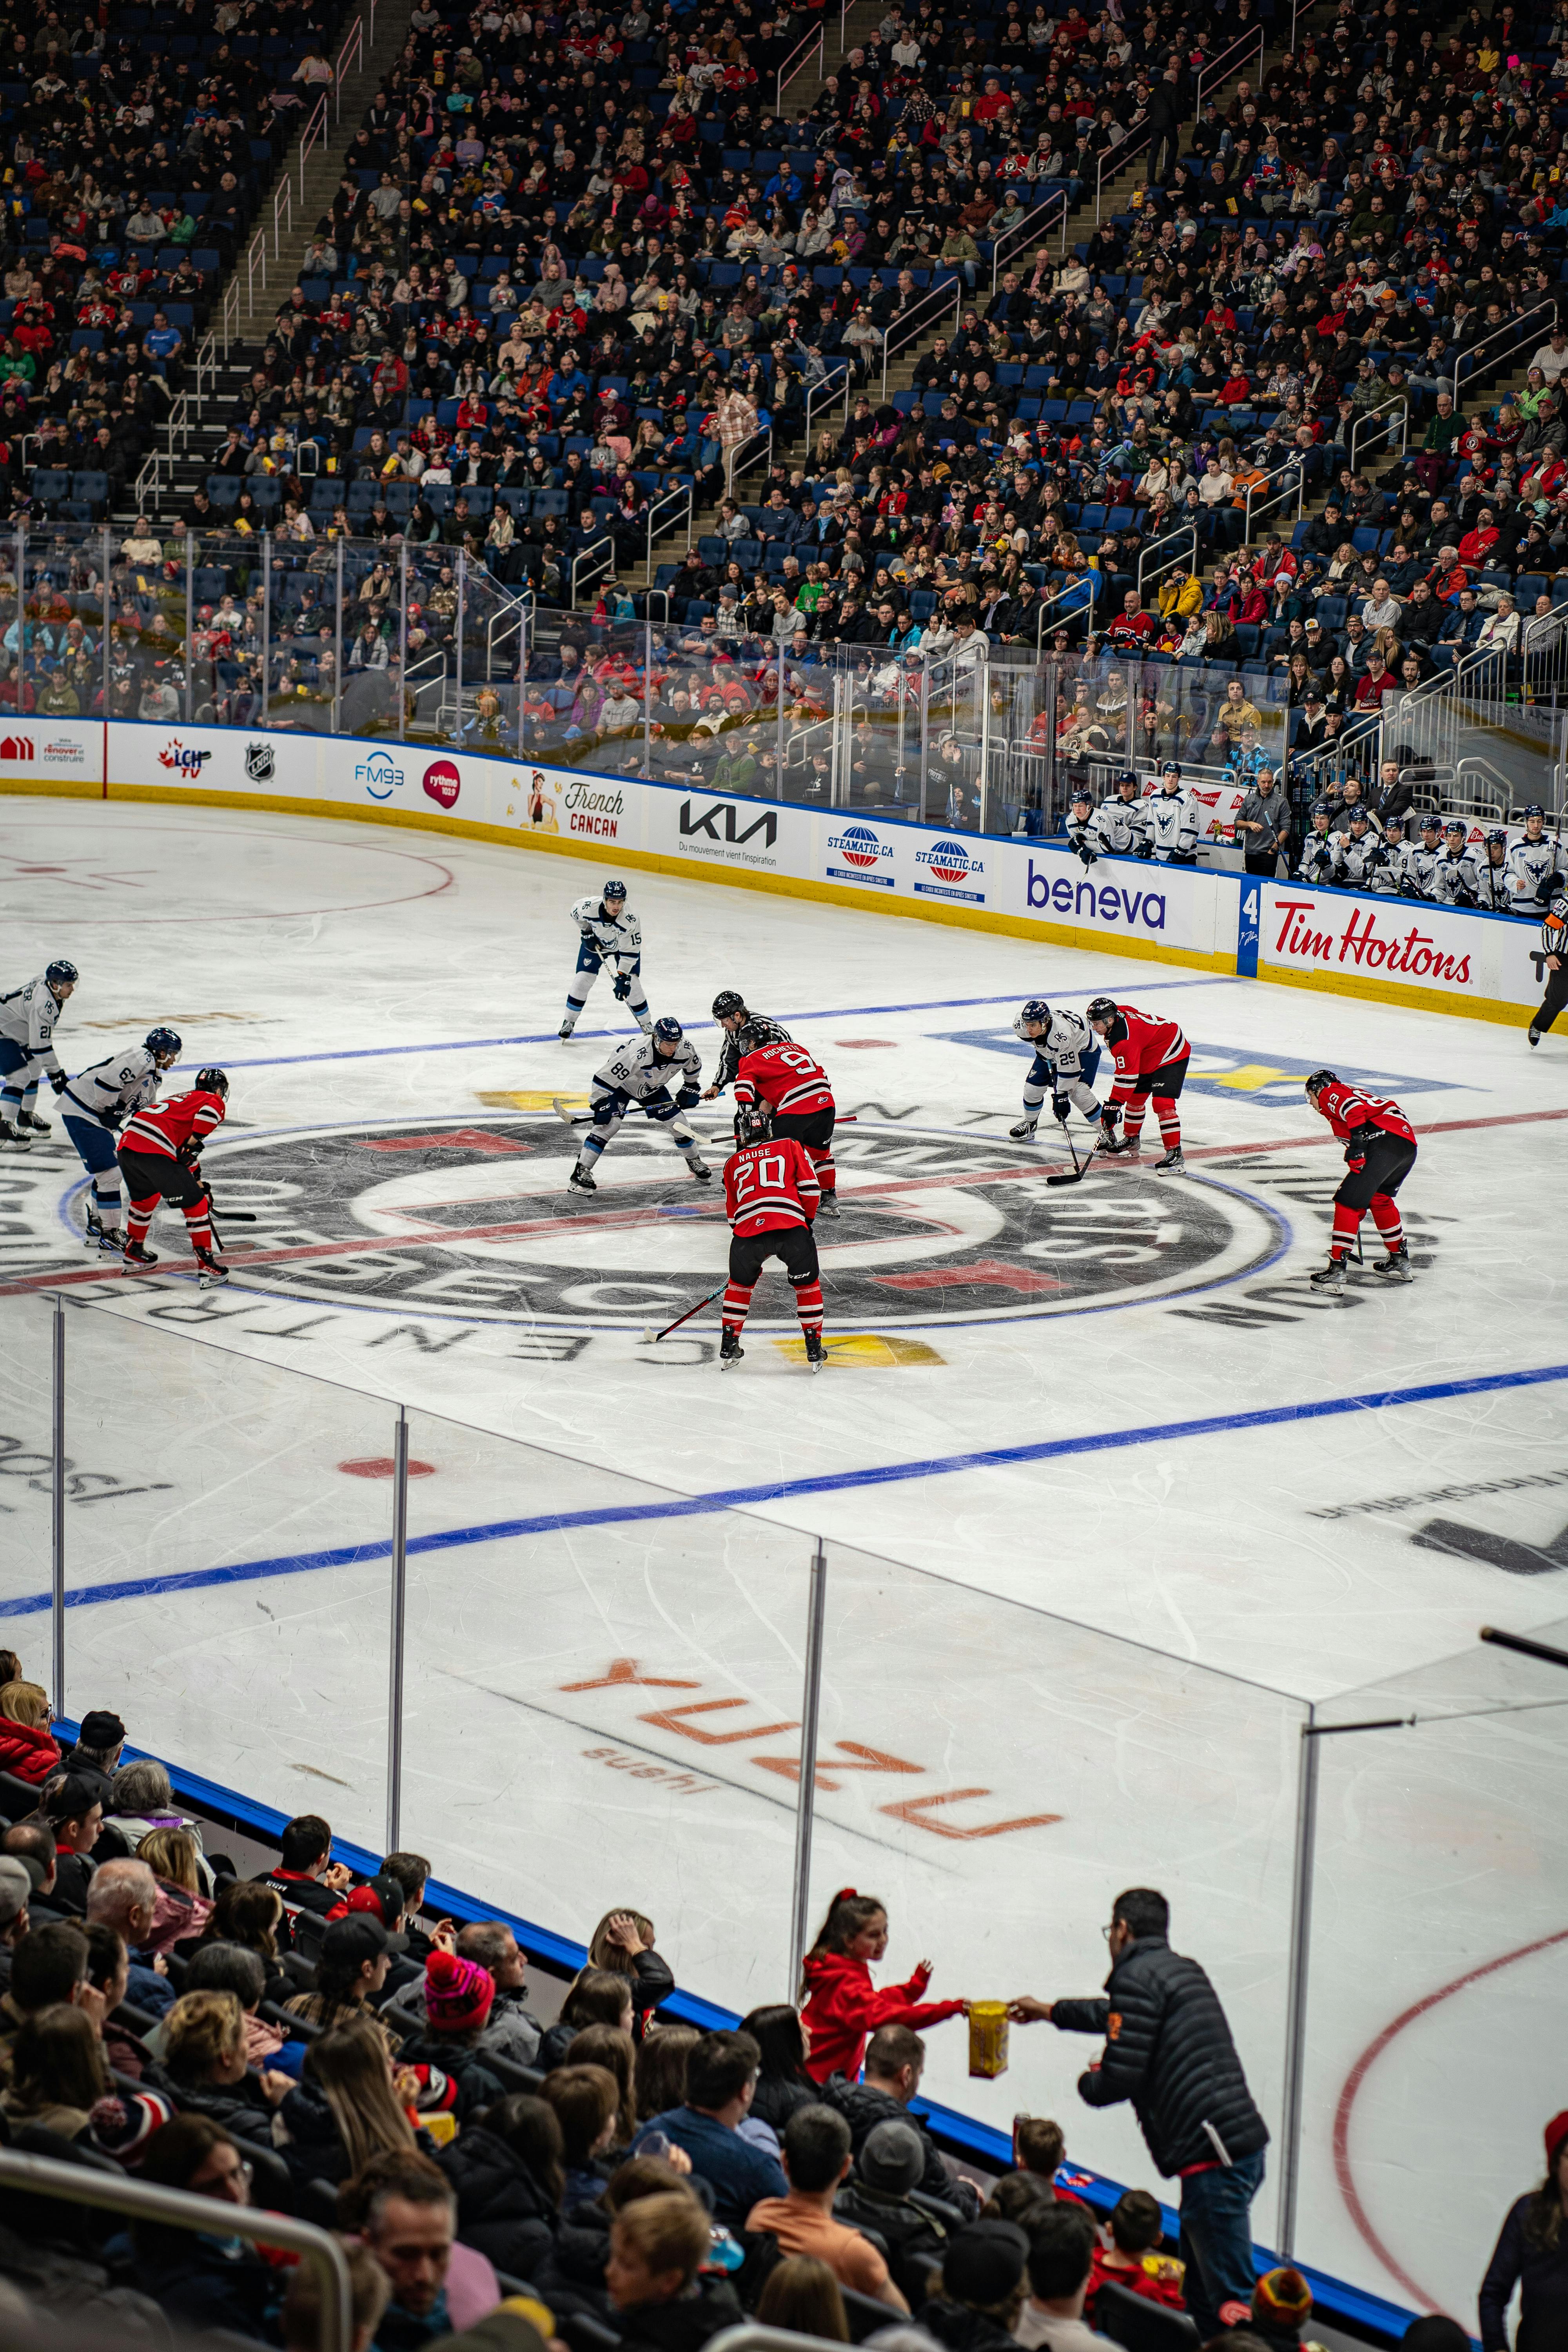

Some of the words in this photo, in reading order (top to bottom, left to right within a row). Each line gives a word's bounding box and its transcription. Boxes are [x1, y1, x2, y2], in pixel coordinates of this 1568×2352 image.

[1142, 630, 1150, 639] 83
[44, 755, 84, 763] construire
[175, 749, 201, 768] LCH
[251, 752, 269, 773] LNH
[181, 768, 201, 779] TV
[355, 765, 404, 786] FM93
[430, 775, 458, 789] rythme
[441, 787, 456, 797] 102.9
[565, 782, 624, 815] French
[570, 813, 617, 838] CANCAN
[1189, 813, 1195, 824] 2
[679, 841, 687, 851] Du
[689, 845, 724, 857] mouvement
[726, 850, 740, 860] vient
[742, 852, 776, 866] l'inspiration
[828, 837, 894, 857] STEAMATIC.CA
[1548, 840, 1553, 849] A
[915, 851, 985, 873] STEAMATIC.CA
[1401, 858, 1407, 869] 9
[846, 871, 862, 880] INCONTESTÉ
[875, 877, 887, 885] SINISTRE
[934, 887, 951, 895] INCONTESTÉ
[1027, 859, 1165, 929] beneva
[1242, 889, 1257, 925] 4
[630, 932, 642, 946] 15
[1275, 902, 1333, 961] Tim
[1338, 907, 1471, 983] Hortons
[40, 1025, 51, 1039] 21
[762, 1044, 802, 1060] ROCHETTE
[1059, 1051, 1076, 1066] 29
[610, 1062, 630, 1081] 89
[780, 1051, 817, 1075] 9
[1117, 1056, 1125, 1069] 8
[119, 1067, 136, 1085] 67
[682, 1085, 699, 1094] CCM
[1327, 1093, 1339, 1114] 83
[751, 1119, 761, 1127] 20
[1093, 1129, 1105, 1154] CCM
[739, 1147, 771, 1163] NAUSE
[733, 1154, 786, 1203] 20
[558, 1657, 1064, 1840] YUZU
[582, 1747, 720, 1795] sushi
